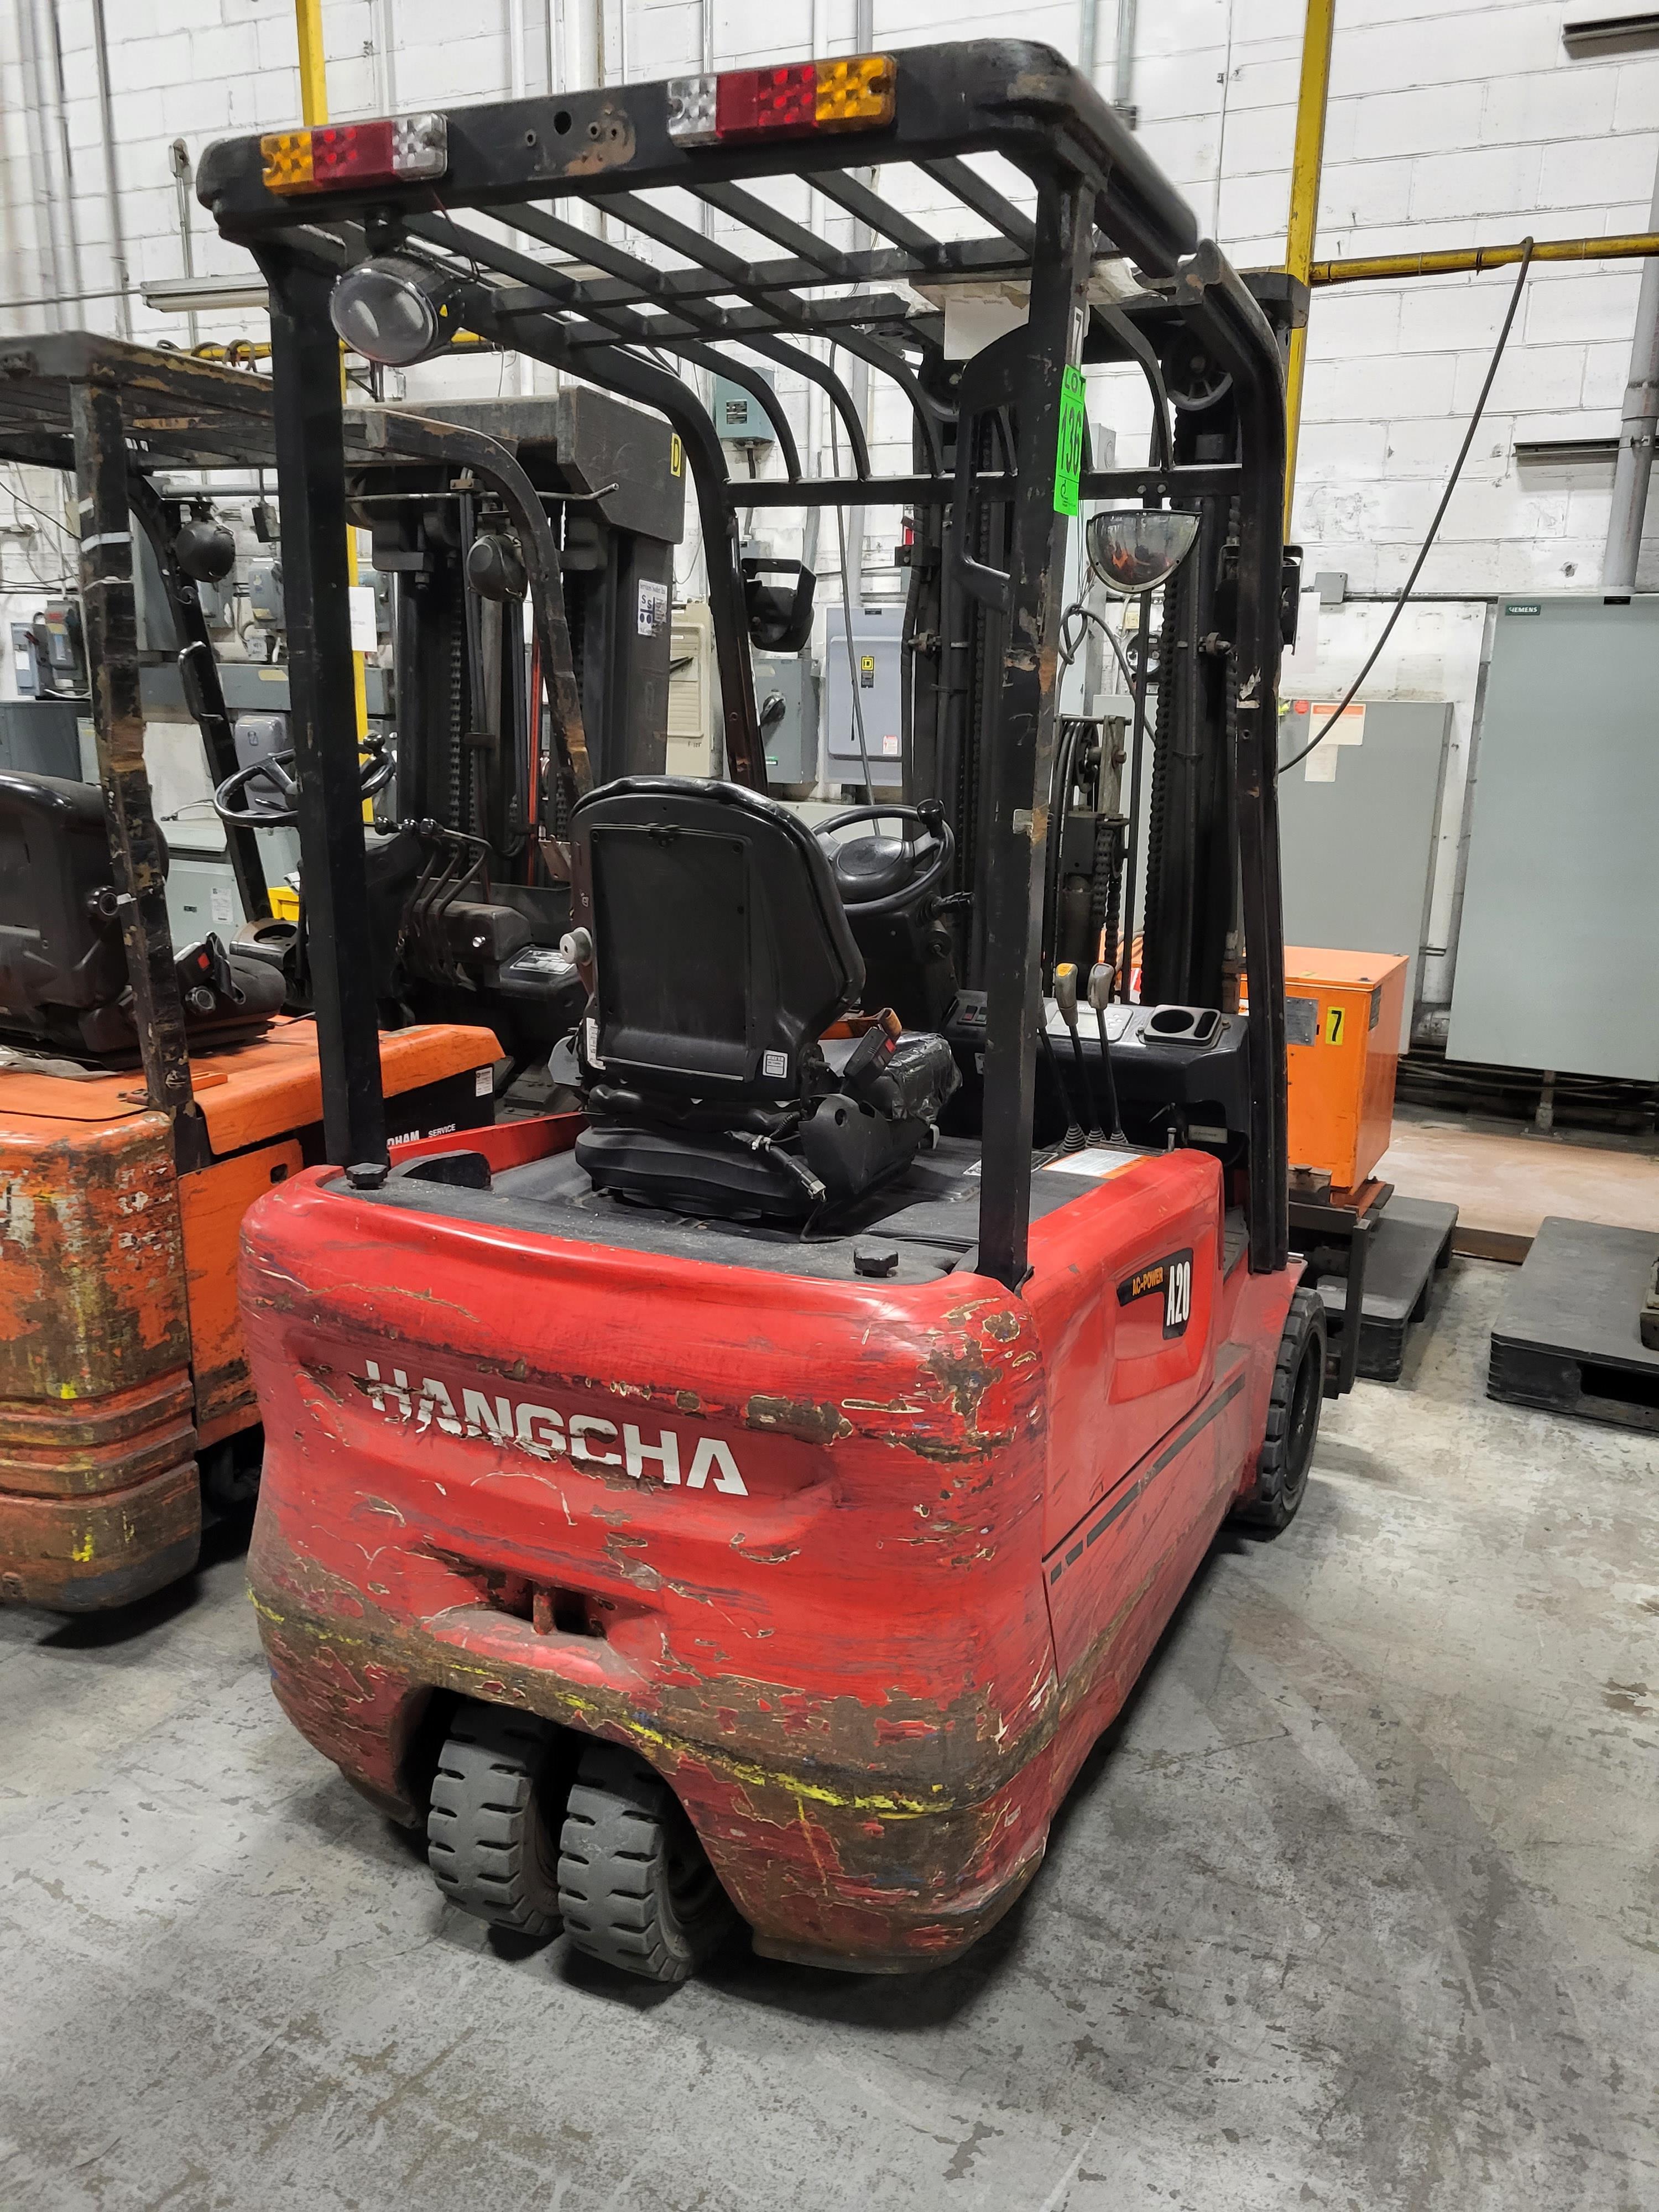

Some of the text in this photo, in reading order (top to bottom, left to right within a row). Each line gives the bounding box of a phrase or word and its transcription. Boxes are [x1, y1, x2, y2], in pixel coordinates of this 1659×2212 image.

[1065, 368, 1086, 397] LOT
[1061, 402, 1081, 476] 136
[1331, 1010, 1342, 1042] 7
[428, 1124, 456, 1138] SERVICE
[1132, 1261, 1191, 1327] AC-POWER A20
[365, 1359, 749, 1496] HANGCHA
